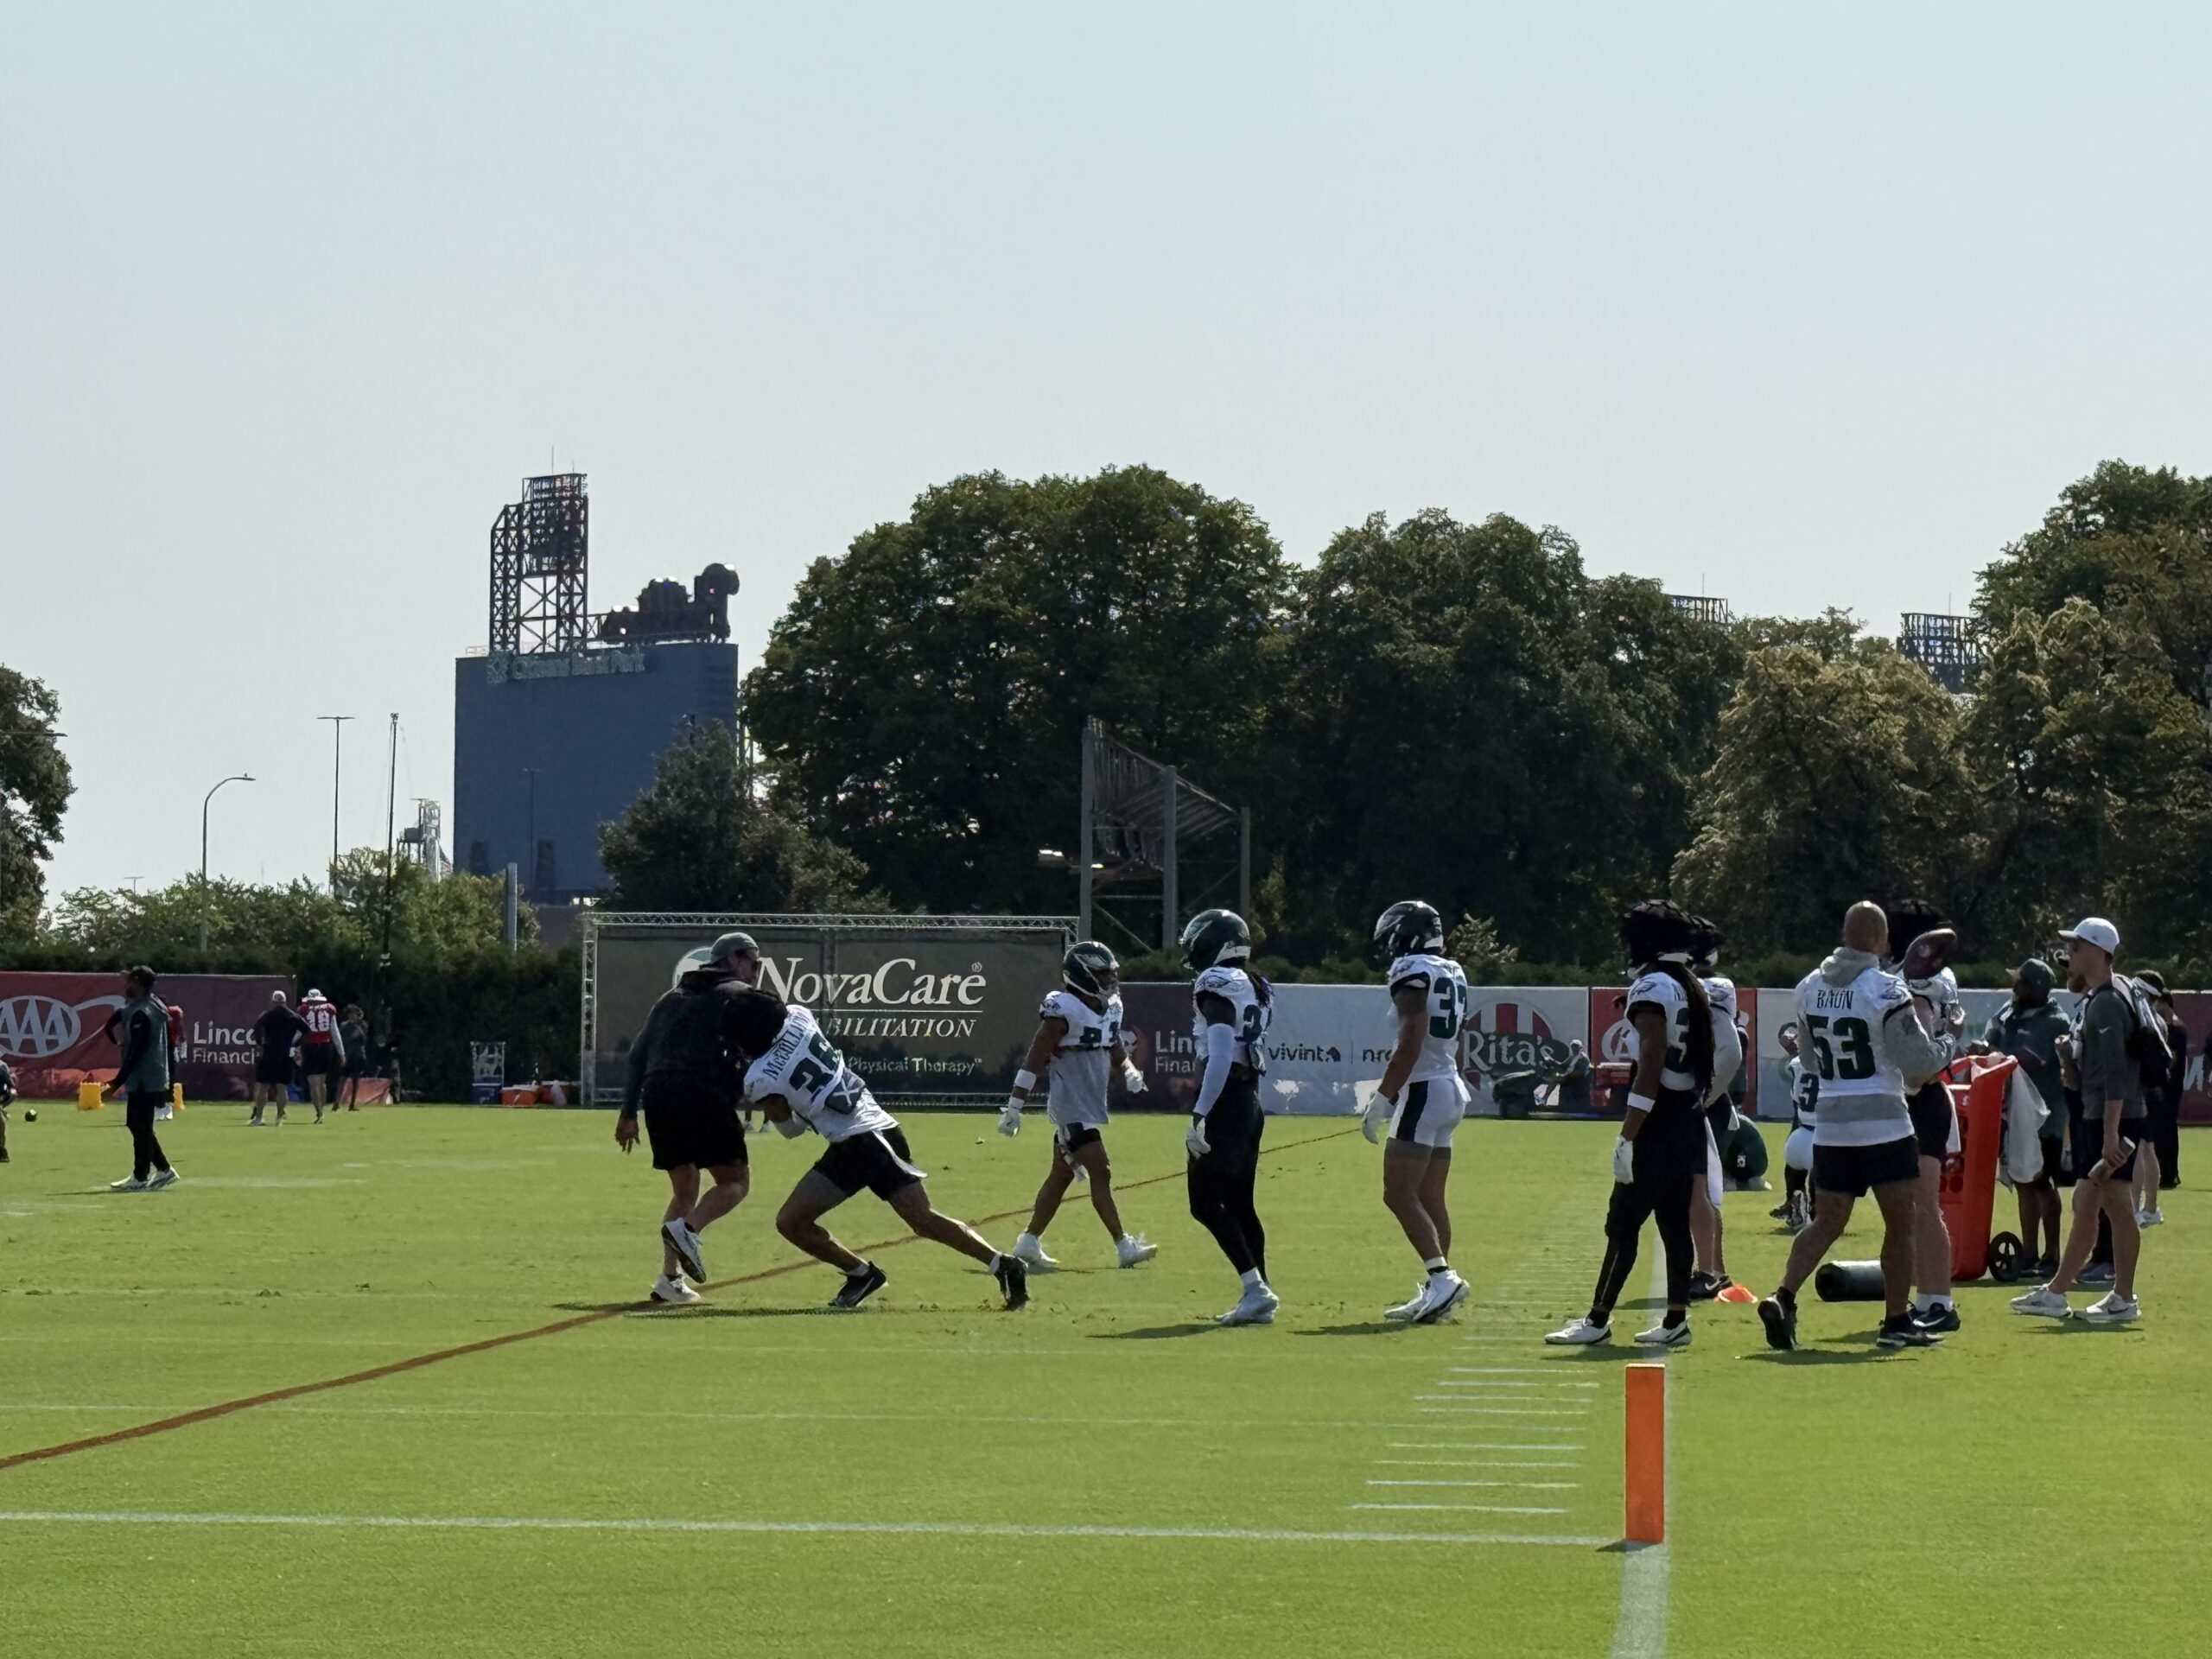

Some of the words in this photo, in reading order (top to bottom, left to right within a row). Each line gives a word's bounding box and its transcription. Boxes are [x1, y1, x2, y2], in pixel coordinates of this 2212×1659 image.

[194, 1020, 257, 1046] Linco
[817, 1017, 976, 1038] BILITATION
[1155, 1029, 1193, 1053] Lin
[1462, 1028, 1554, 1071] Rita's
[1806, 1014, 1877, 1080] 53
[192, 1046, 256, 1065] Financi
[1268, 1043, 1324, 1062] vivint
[848, 1057, 909, 1074] Physical
